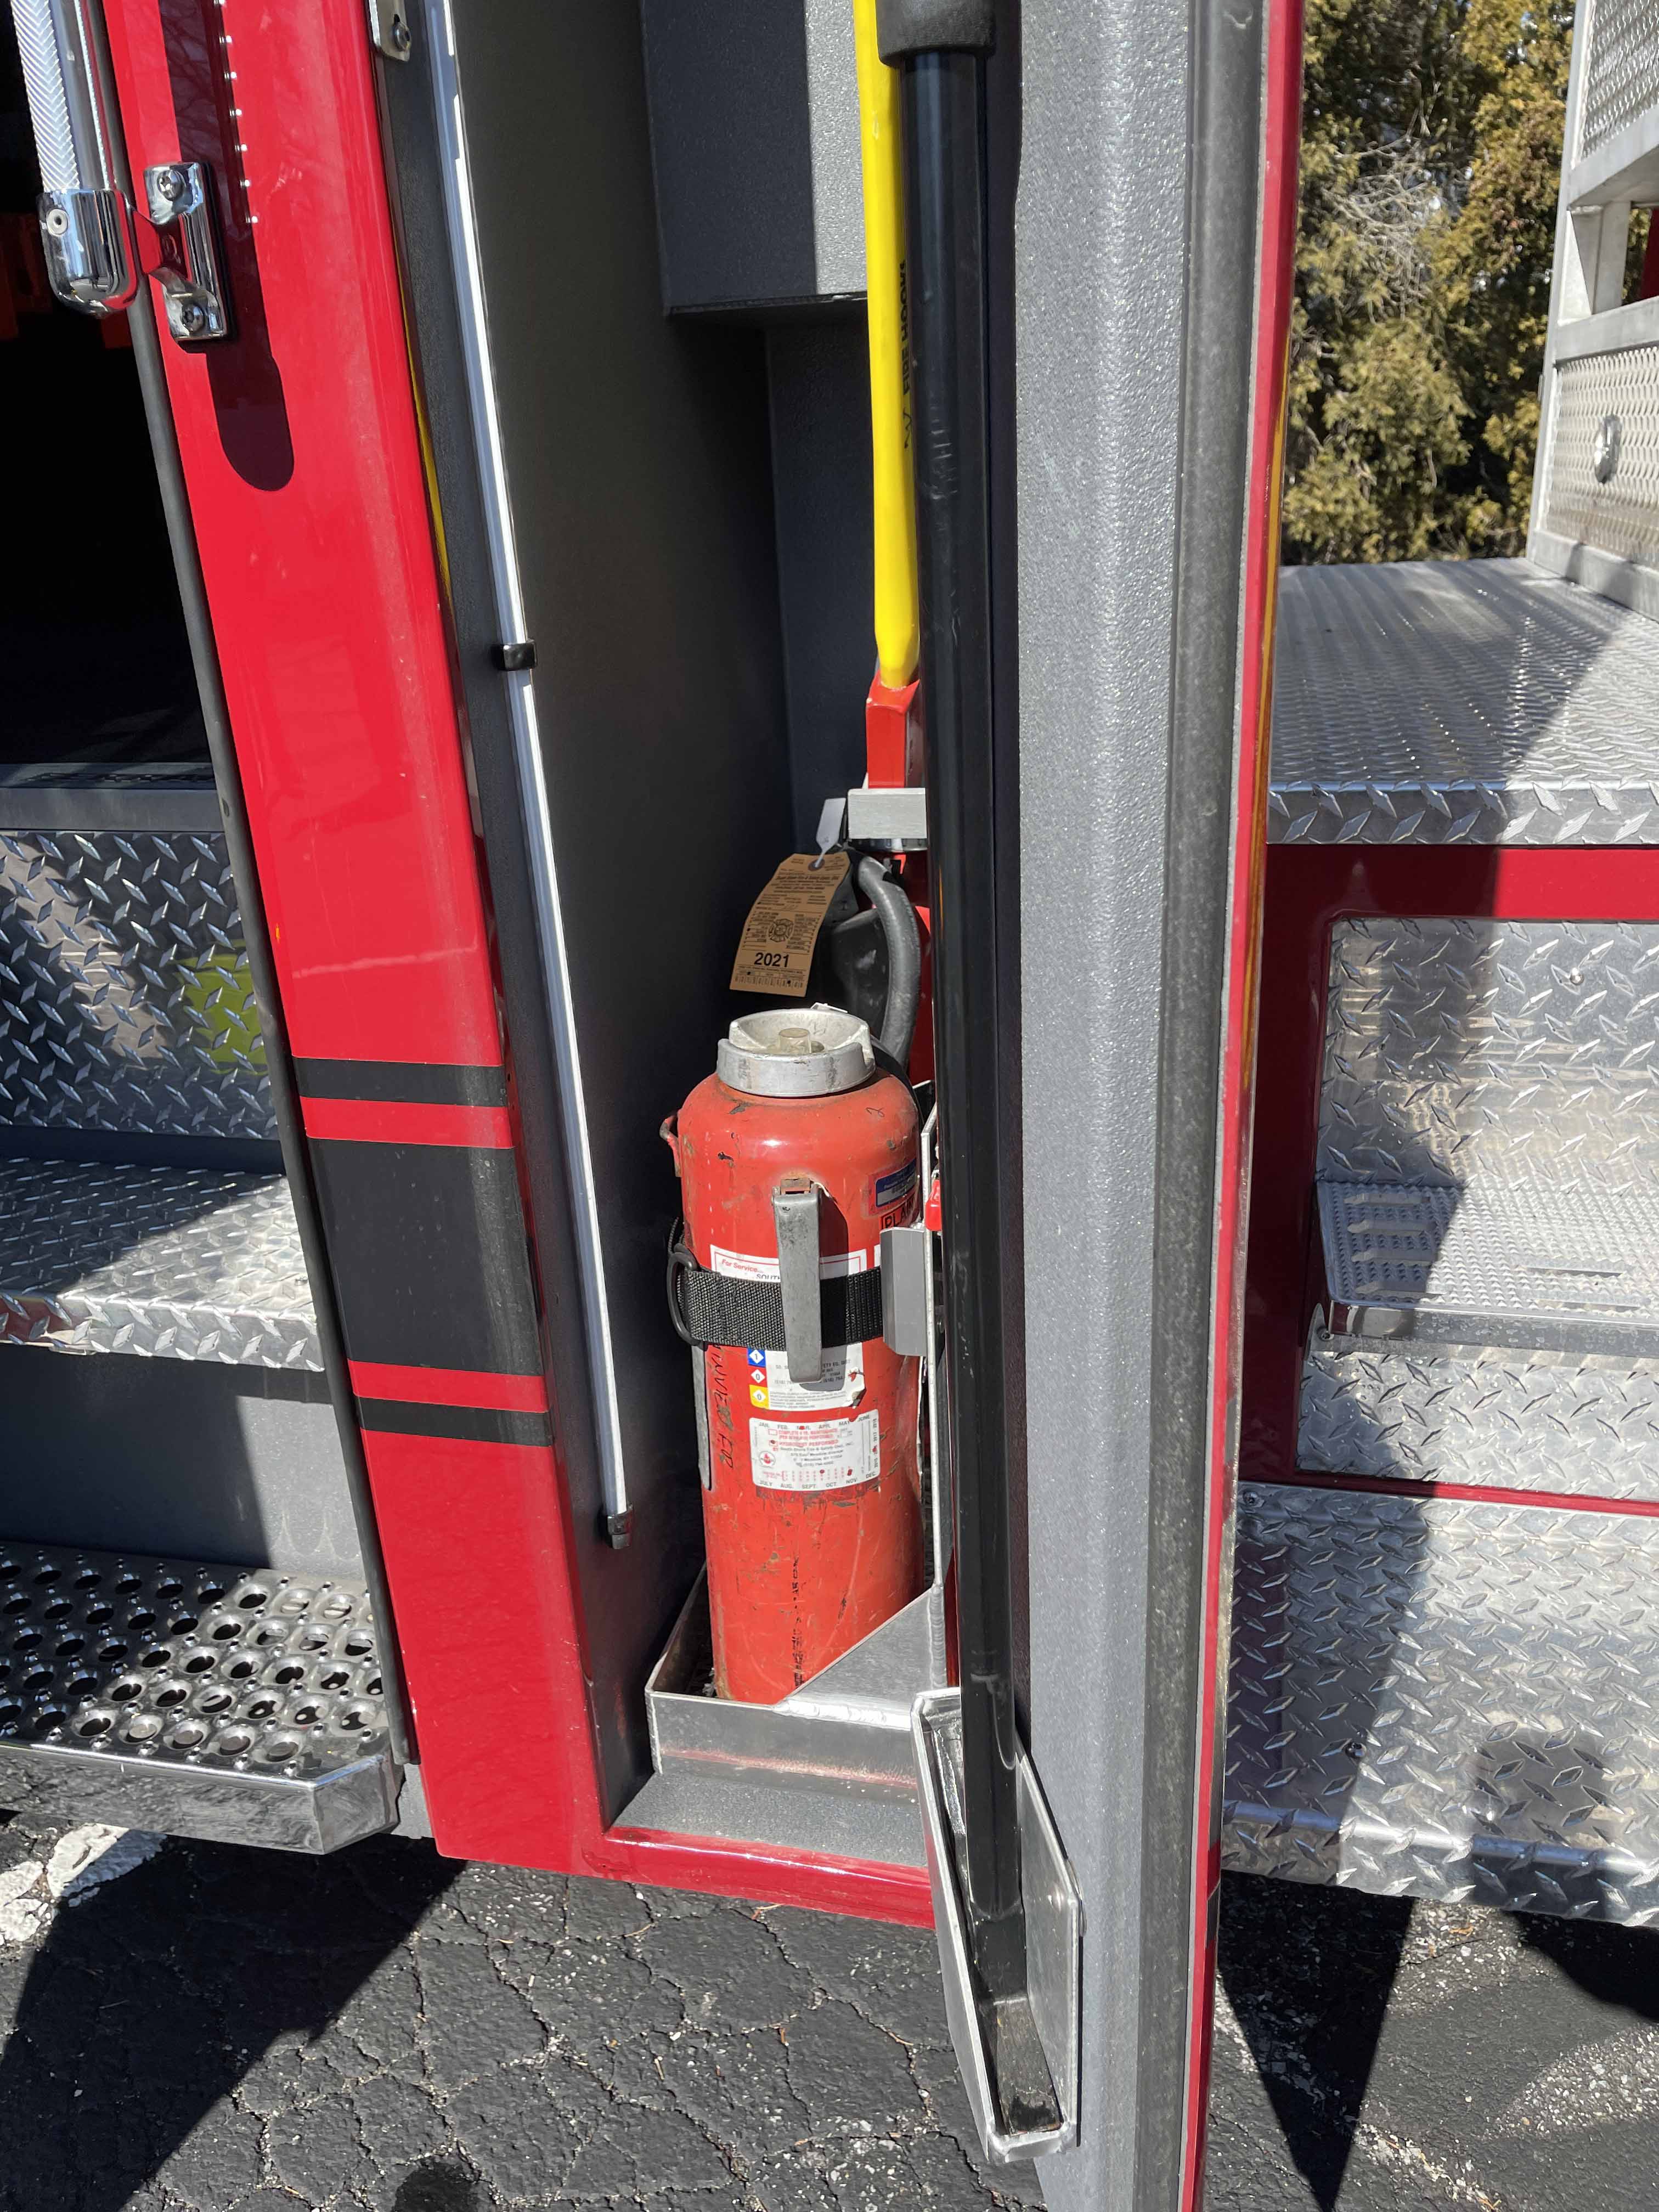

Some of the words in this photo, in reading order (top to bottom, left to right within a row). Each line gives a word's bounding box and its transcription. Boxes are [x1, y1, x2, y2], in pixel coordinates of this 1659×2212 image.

[754, 952, 789, 968] 2021
[721, 1259, 732, 1267] For
[755, 1373, 761, 1381] 0
